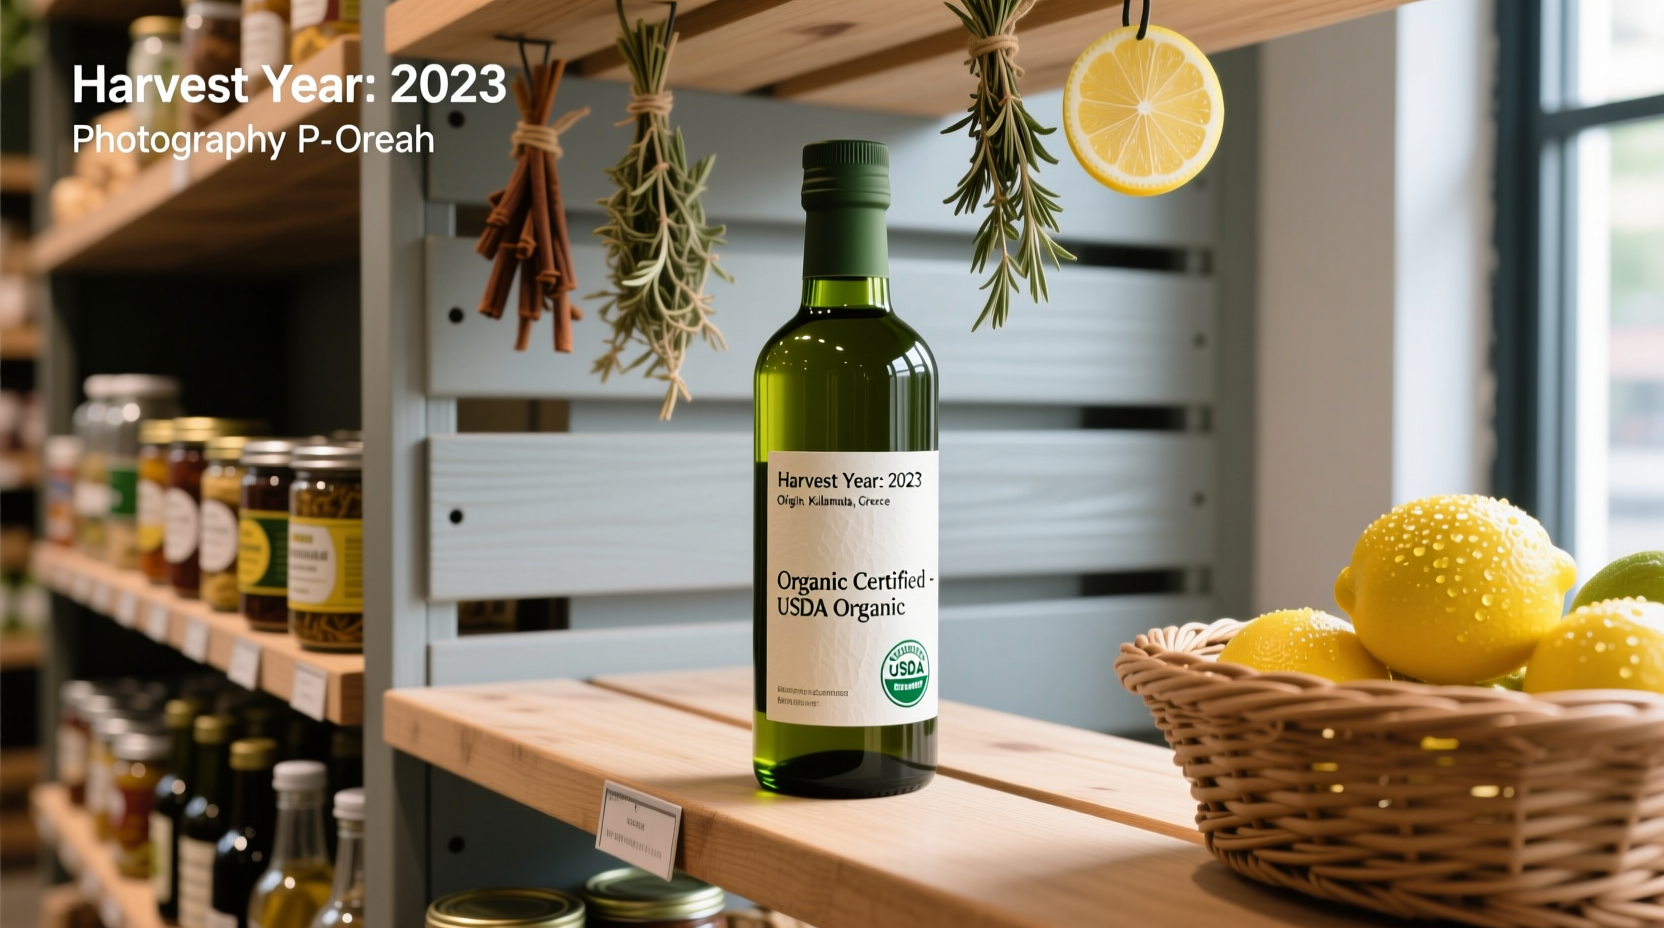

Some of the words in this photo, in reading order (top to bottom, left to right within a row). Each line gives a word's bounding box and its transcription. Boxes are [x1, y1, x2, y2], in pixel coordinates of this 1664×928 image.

[777, 470, 839, 489] Harvest
[841, 472, 884, 490] Year:
[887, 471, 922, 488] 2023
[777, 570, 848, 596] Organic
[852, 568, 926, 591] Certified
[776, 596, 829, 618] USDA
[832, 597, 907, 623] Organic
[888, 660, 925, 678] USDA
